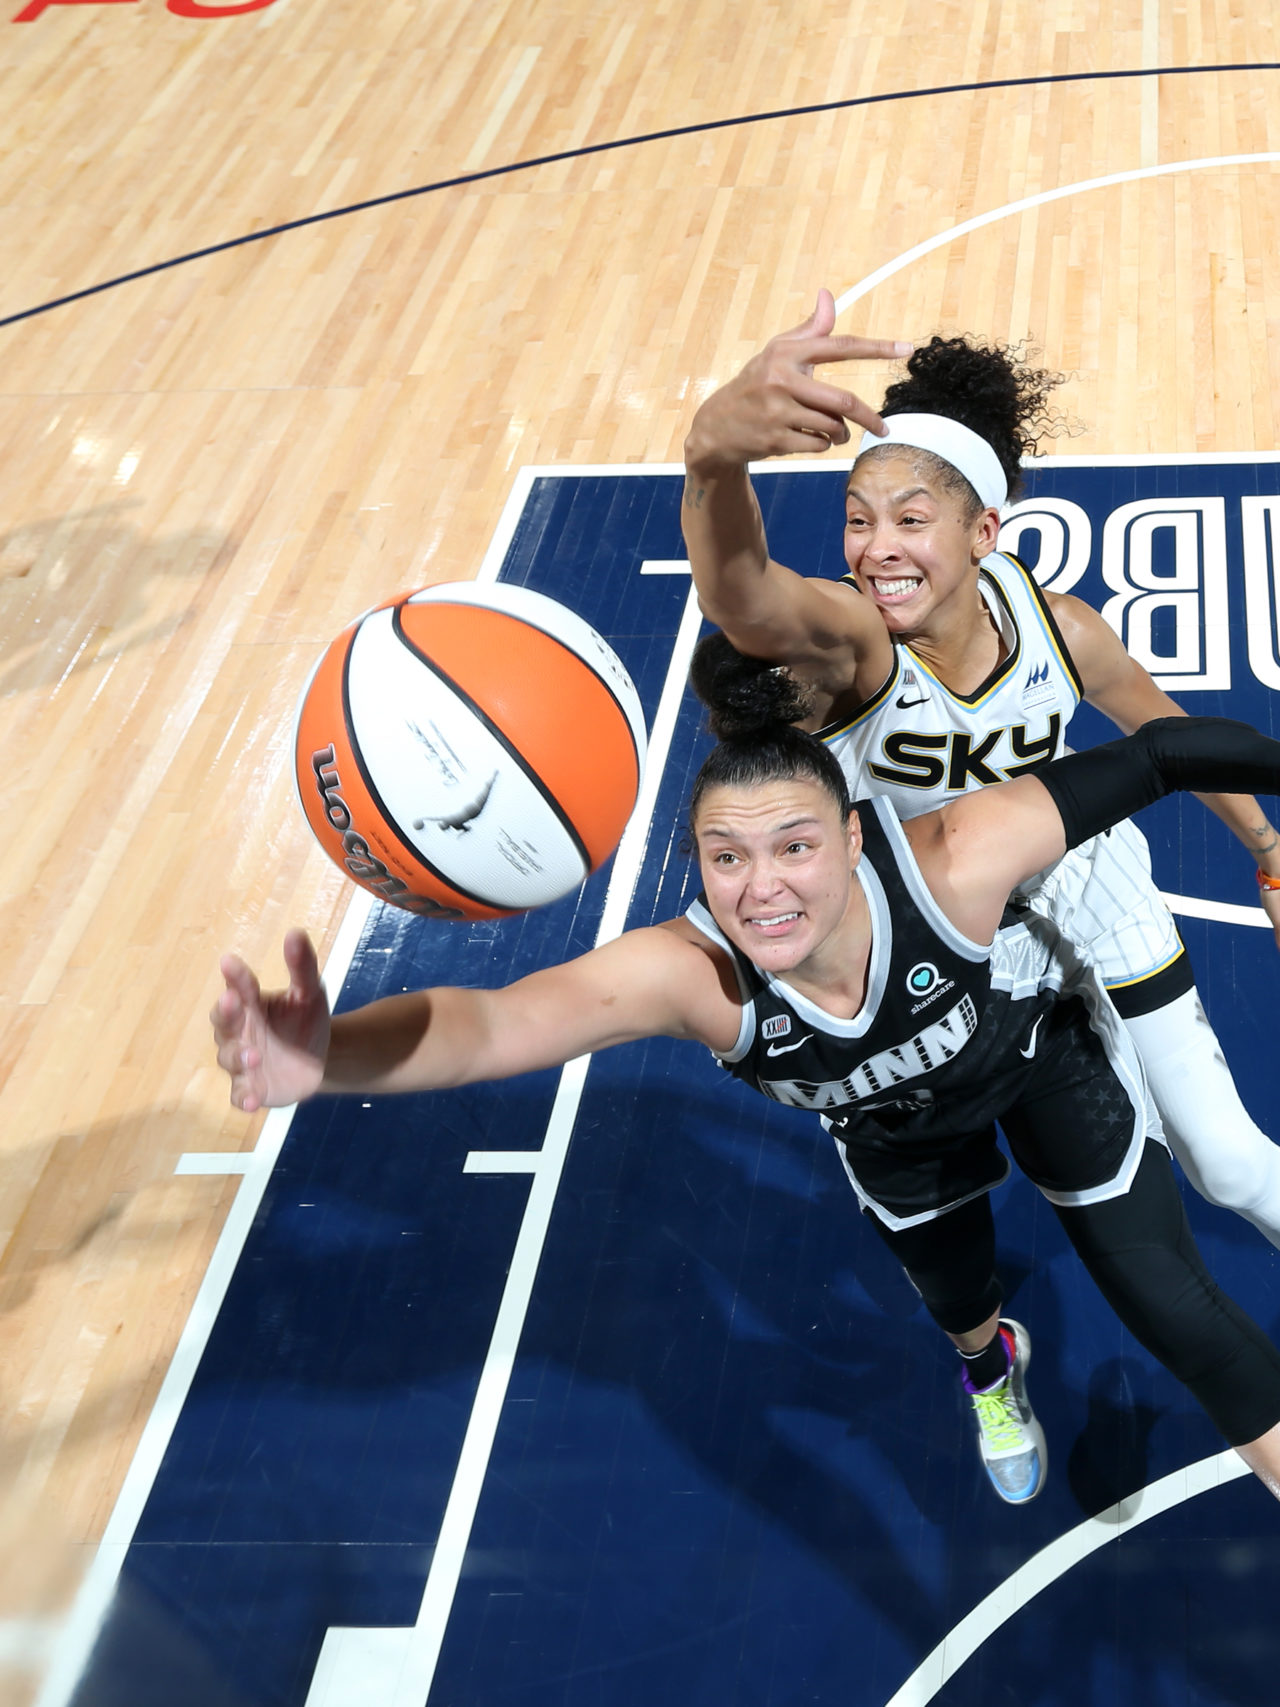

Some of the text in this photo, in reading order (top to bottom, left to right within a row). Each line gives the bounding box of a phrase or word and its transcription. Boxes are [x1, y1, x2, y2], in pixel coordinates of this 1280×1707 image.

[866, 712, 1062, 792] SKY
[910, 979, 956, 1016] sharecare
[771, 1005, 971, 1110] MINN
